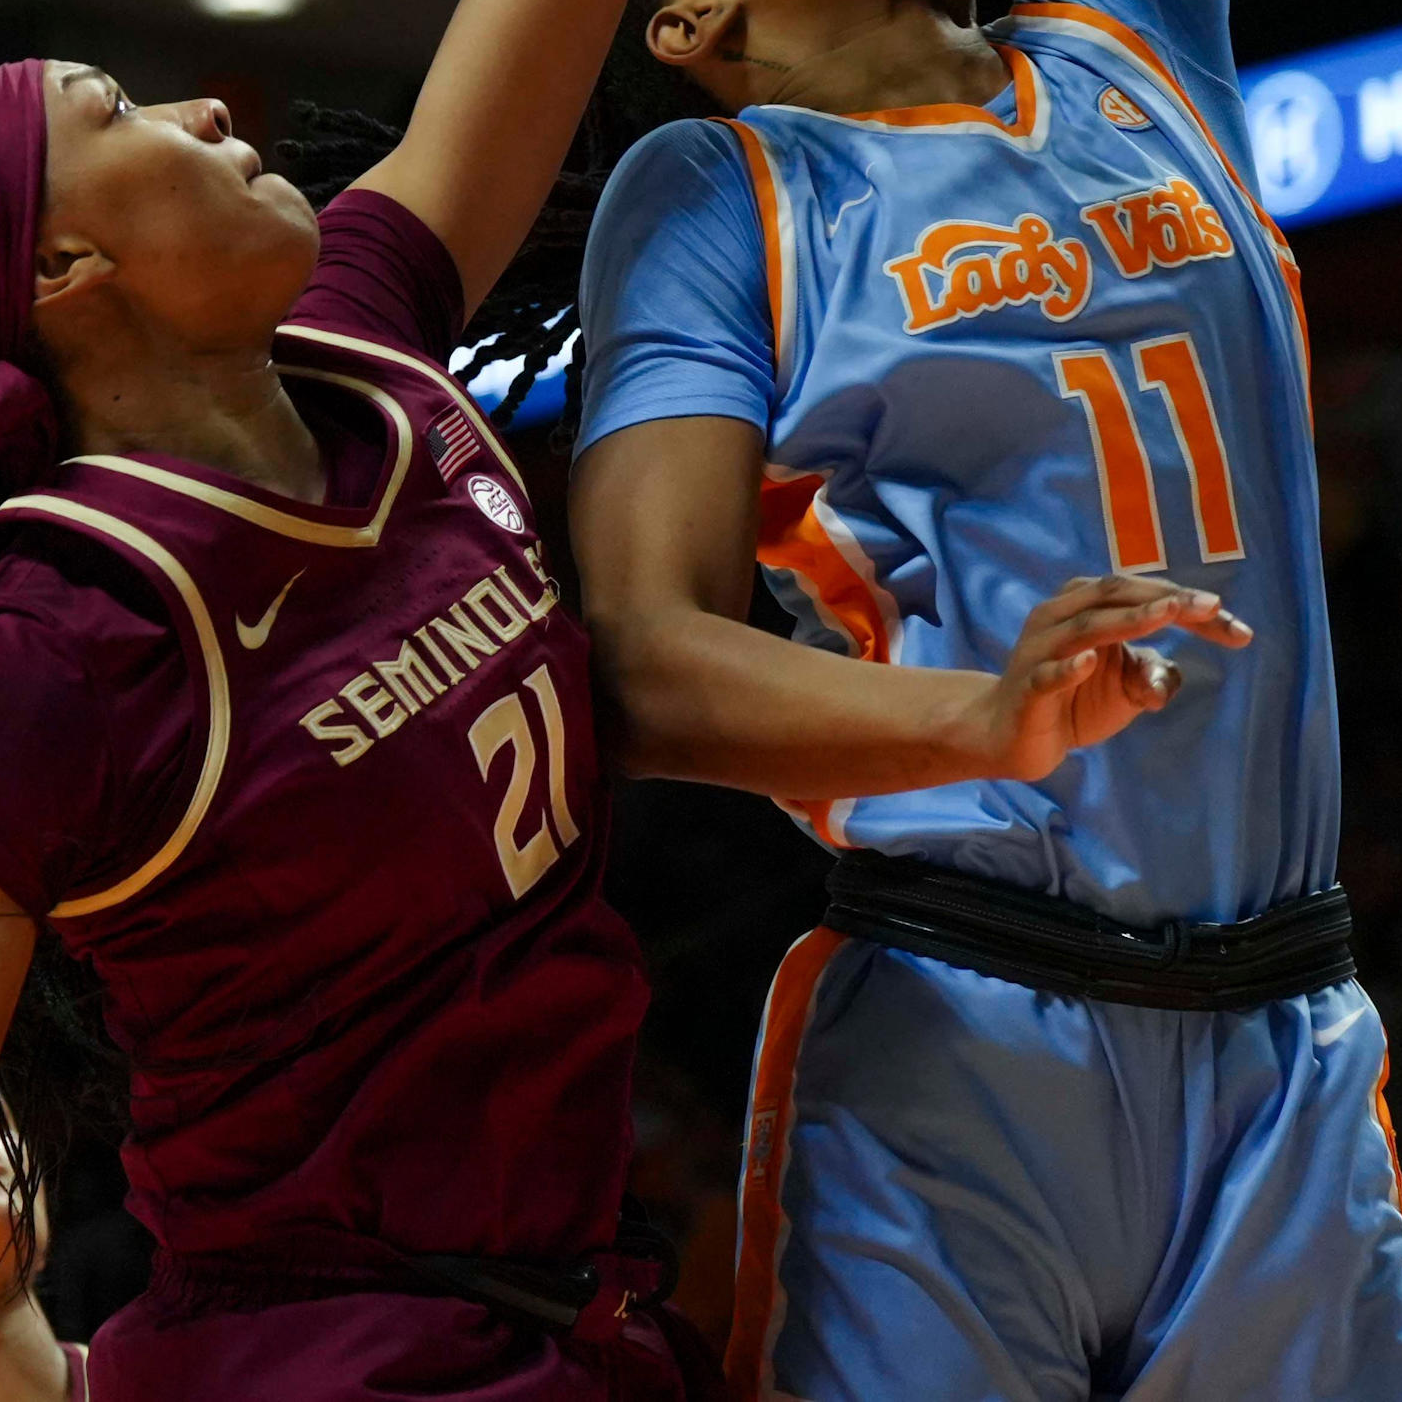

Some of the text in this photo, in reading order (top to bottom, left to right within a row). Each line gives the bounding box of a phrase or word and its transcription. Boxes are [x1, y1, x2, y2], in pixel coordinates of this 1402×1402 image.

[884, 176, 1235, 335] Lady Vols
[1051, 332, 1246, 575] 11
[468, 664, 580, 900] 21
